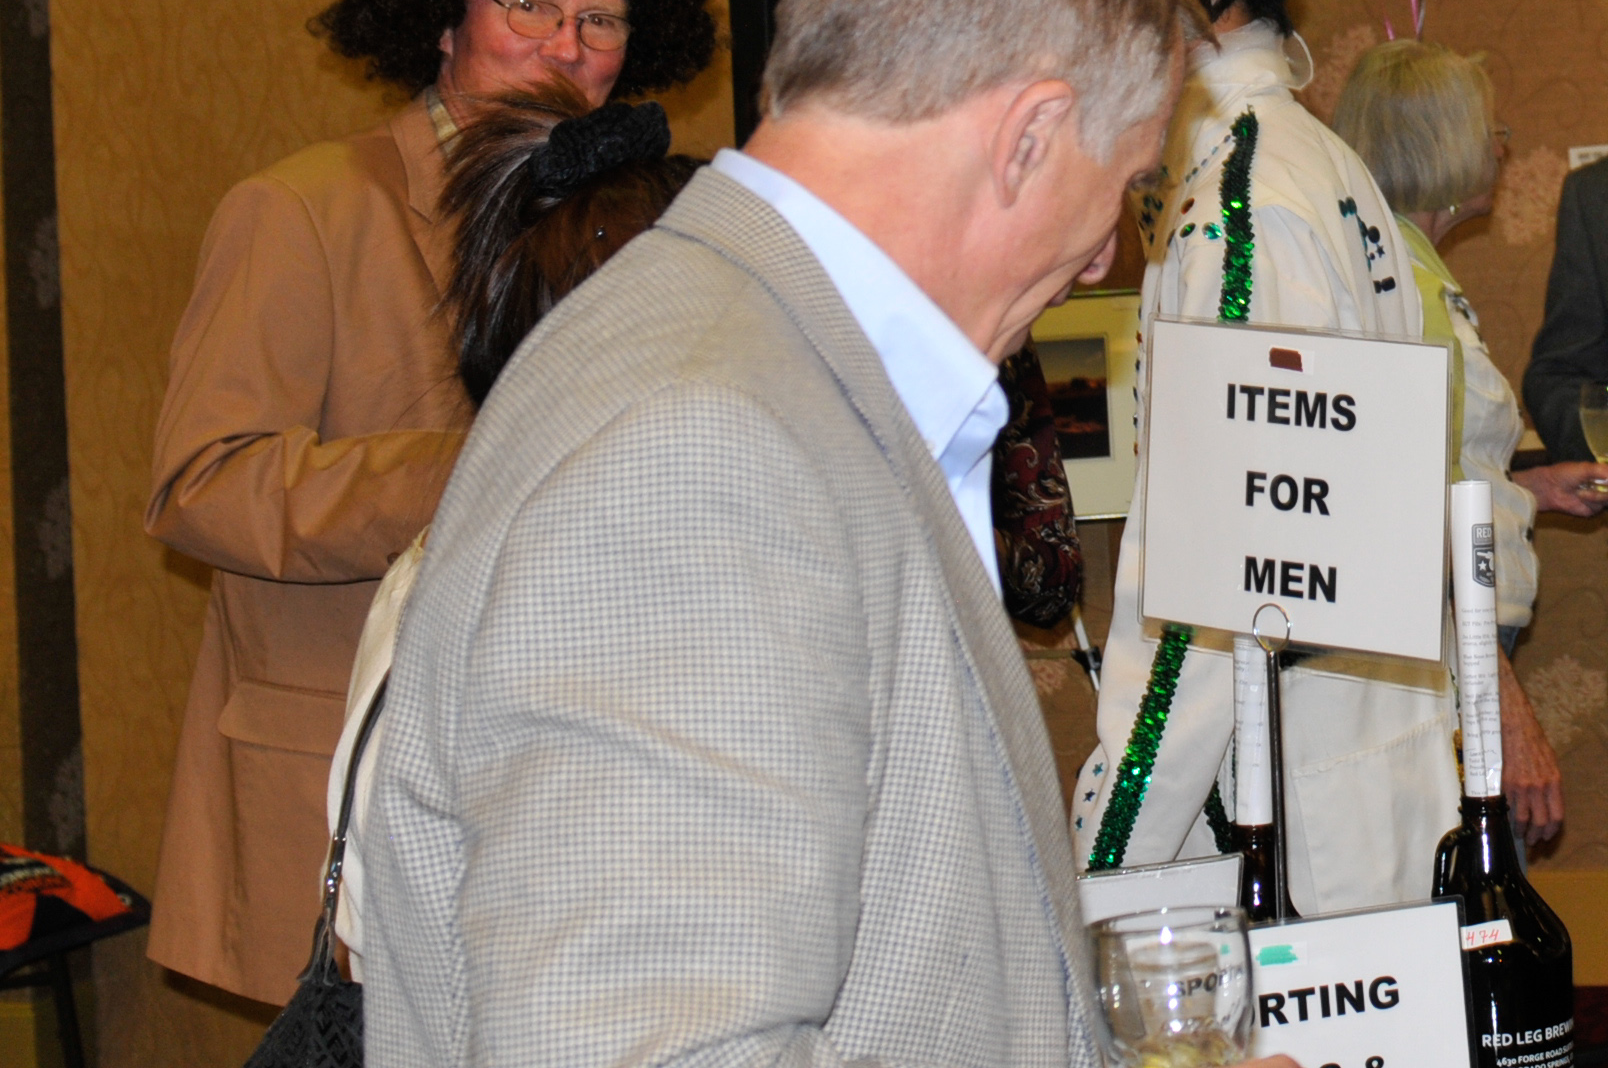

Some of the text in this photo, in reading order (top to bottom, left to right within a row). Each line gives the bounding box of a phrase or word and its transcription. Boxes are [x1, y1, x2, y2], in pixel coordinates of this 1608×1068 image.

[1226, 383, 1357, 431] ITEMS
[1245, 470, 1331, 516] FOR
[1476, 527, 1492, 538] RED
[1244, 555, 1338, 603] MEN
[1465, 928, 1500, 946] 474
[1250, 975, 1400, 1028] RTING
[1482, 1018, 1574, 1048] RED LEG BREW
[1496, 1057, 1516, 1068] 4630
[1518, 1052, 1544, 1064] FORGE
[1545, 1047, 1562, 1059] ROAD
